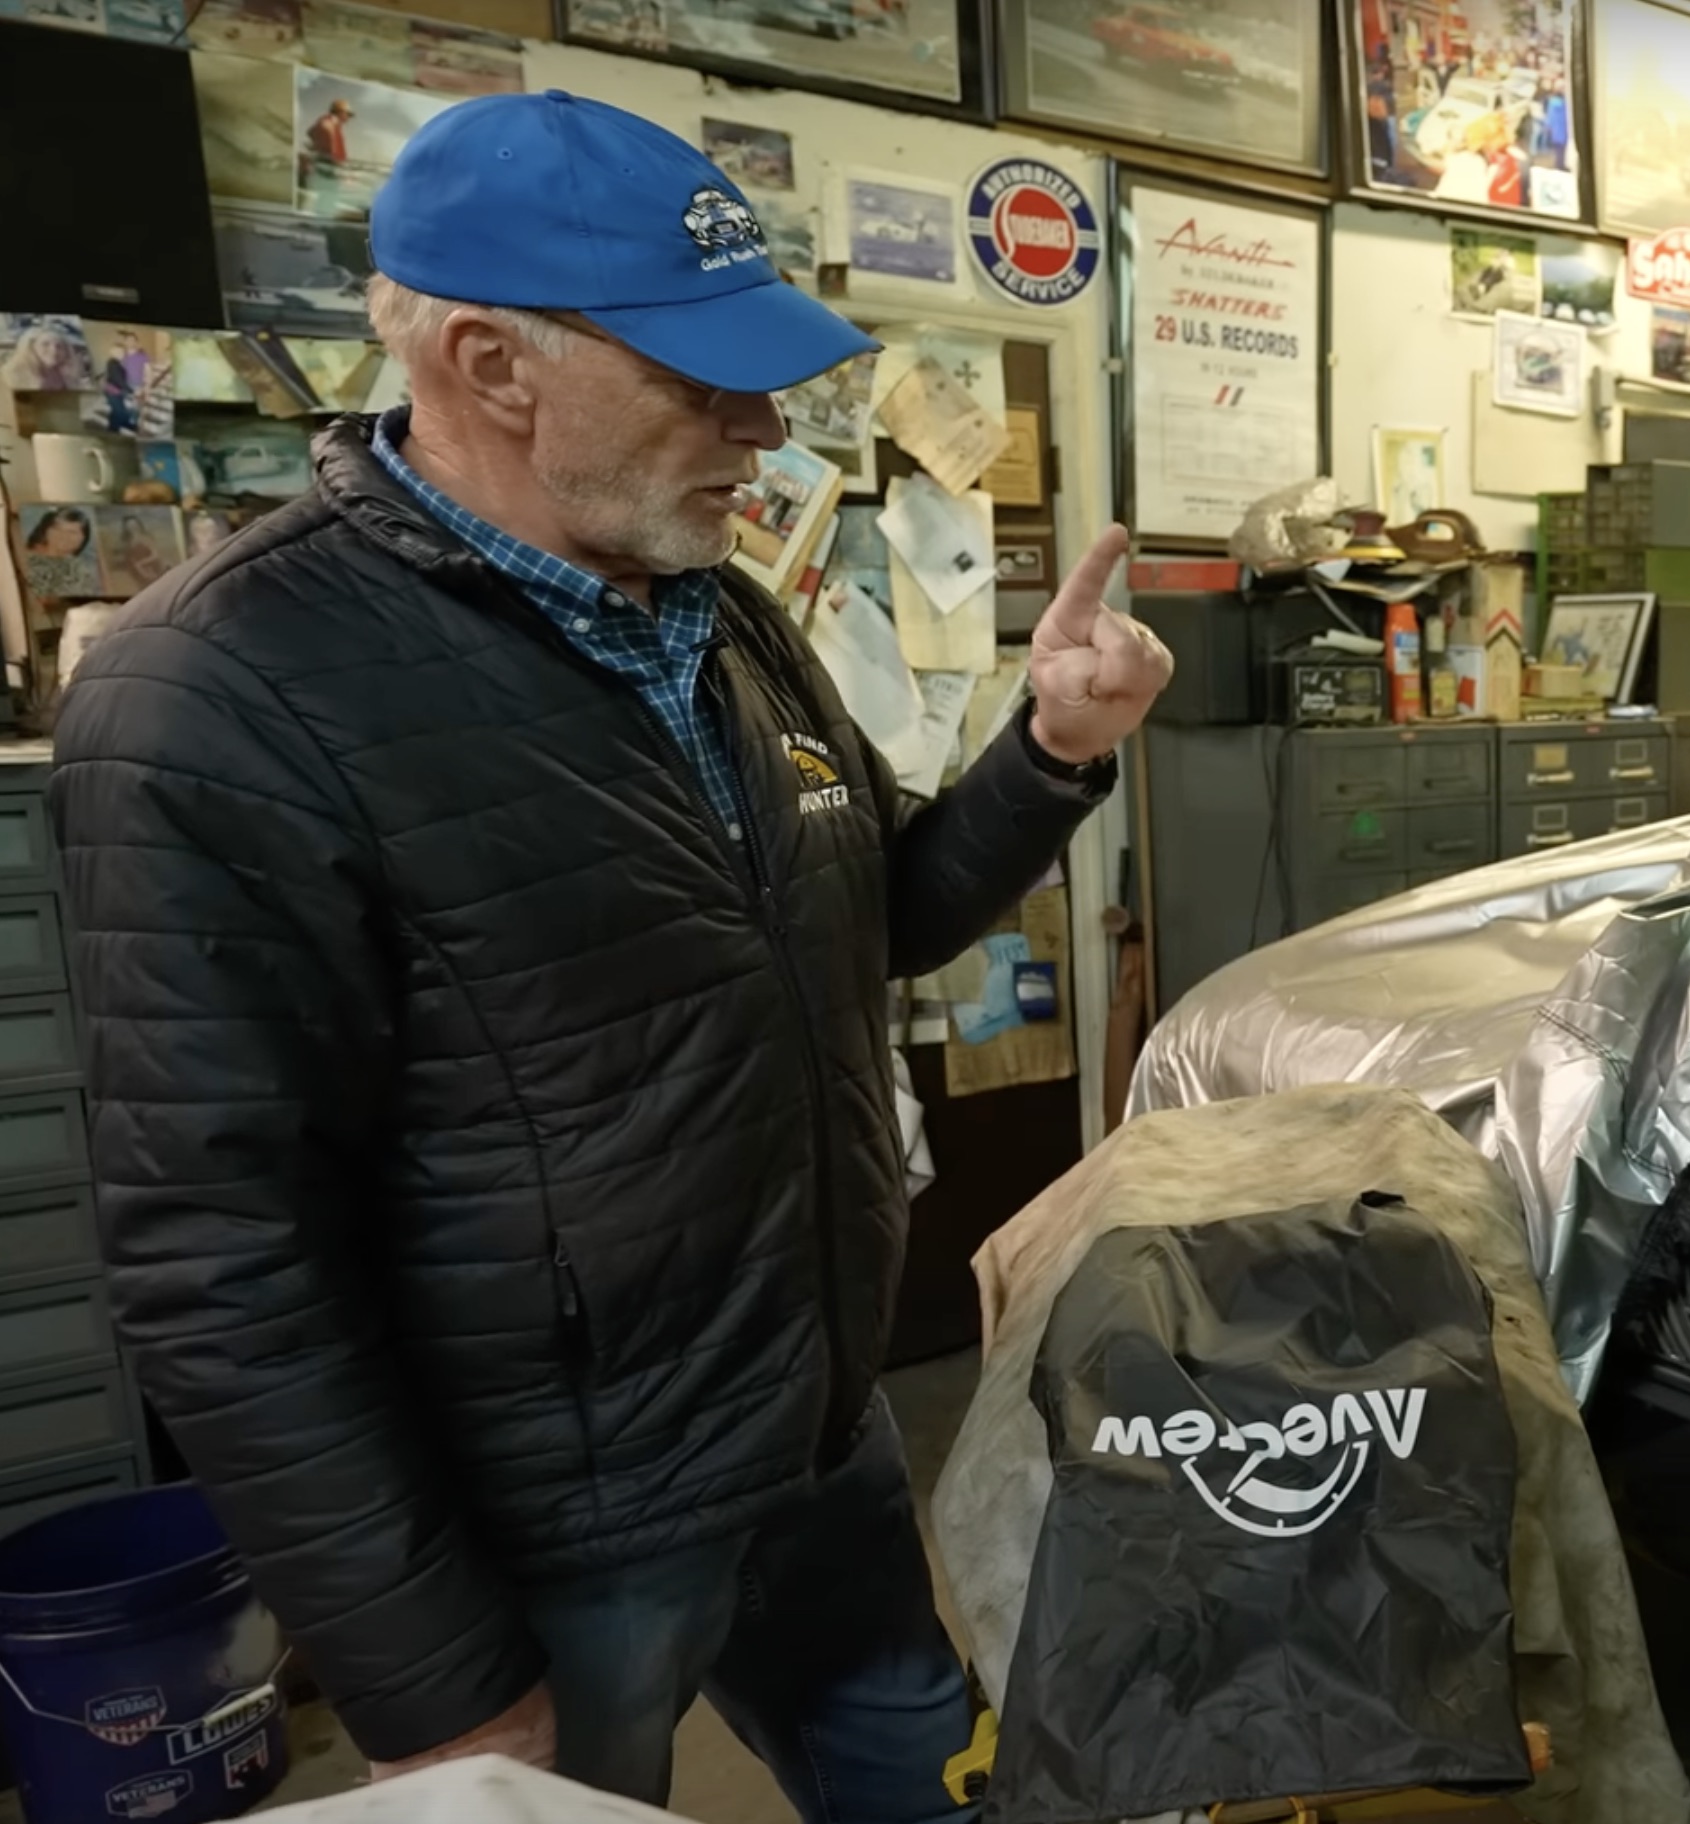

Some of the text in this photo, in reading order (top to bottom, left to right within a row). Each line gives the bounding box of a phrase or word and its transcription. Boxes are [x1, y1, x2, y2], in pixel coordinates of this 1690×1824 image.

[981, 164, 1082, 210] AUTHORIZED
[1155, 218, 1296, 268] Avanti
[992, 260, 1085, 300] SERVICE
[1171, 288, 1287, 321] SHATTERS
[1155, 314, 1298, 360] 29 U.S. RECORDS
[799, 784, 849, 815] HUNTER
[93, 1696, 160, 1722] VETERANS
[112, 1776, 185, 1802] VETERANS
